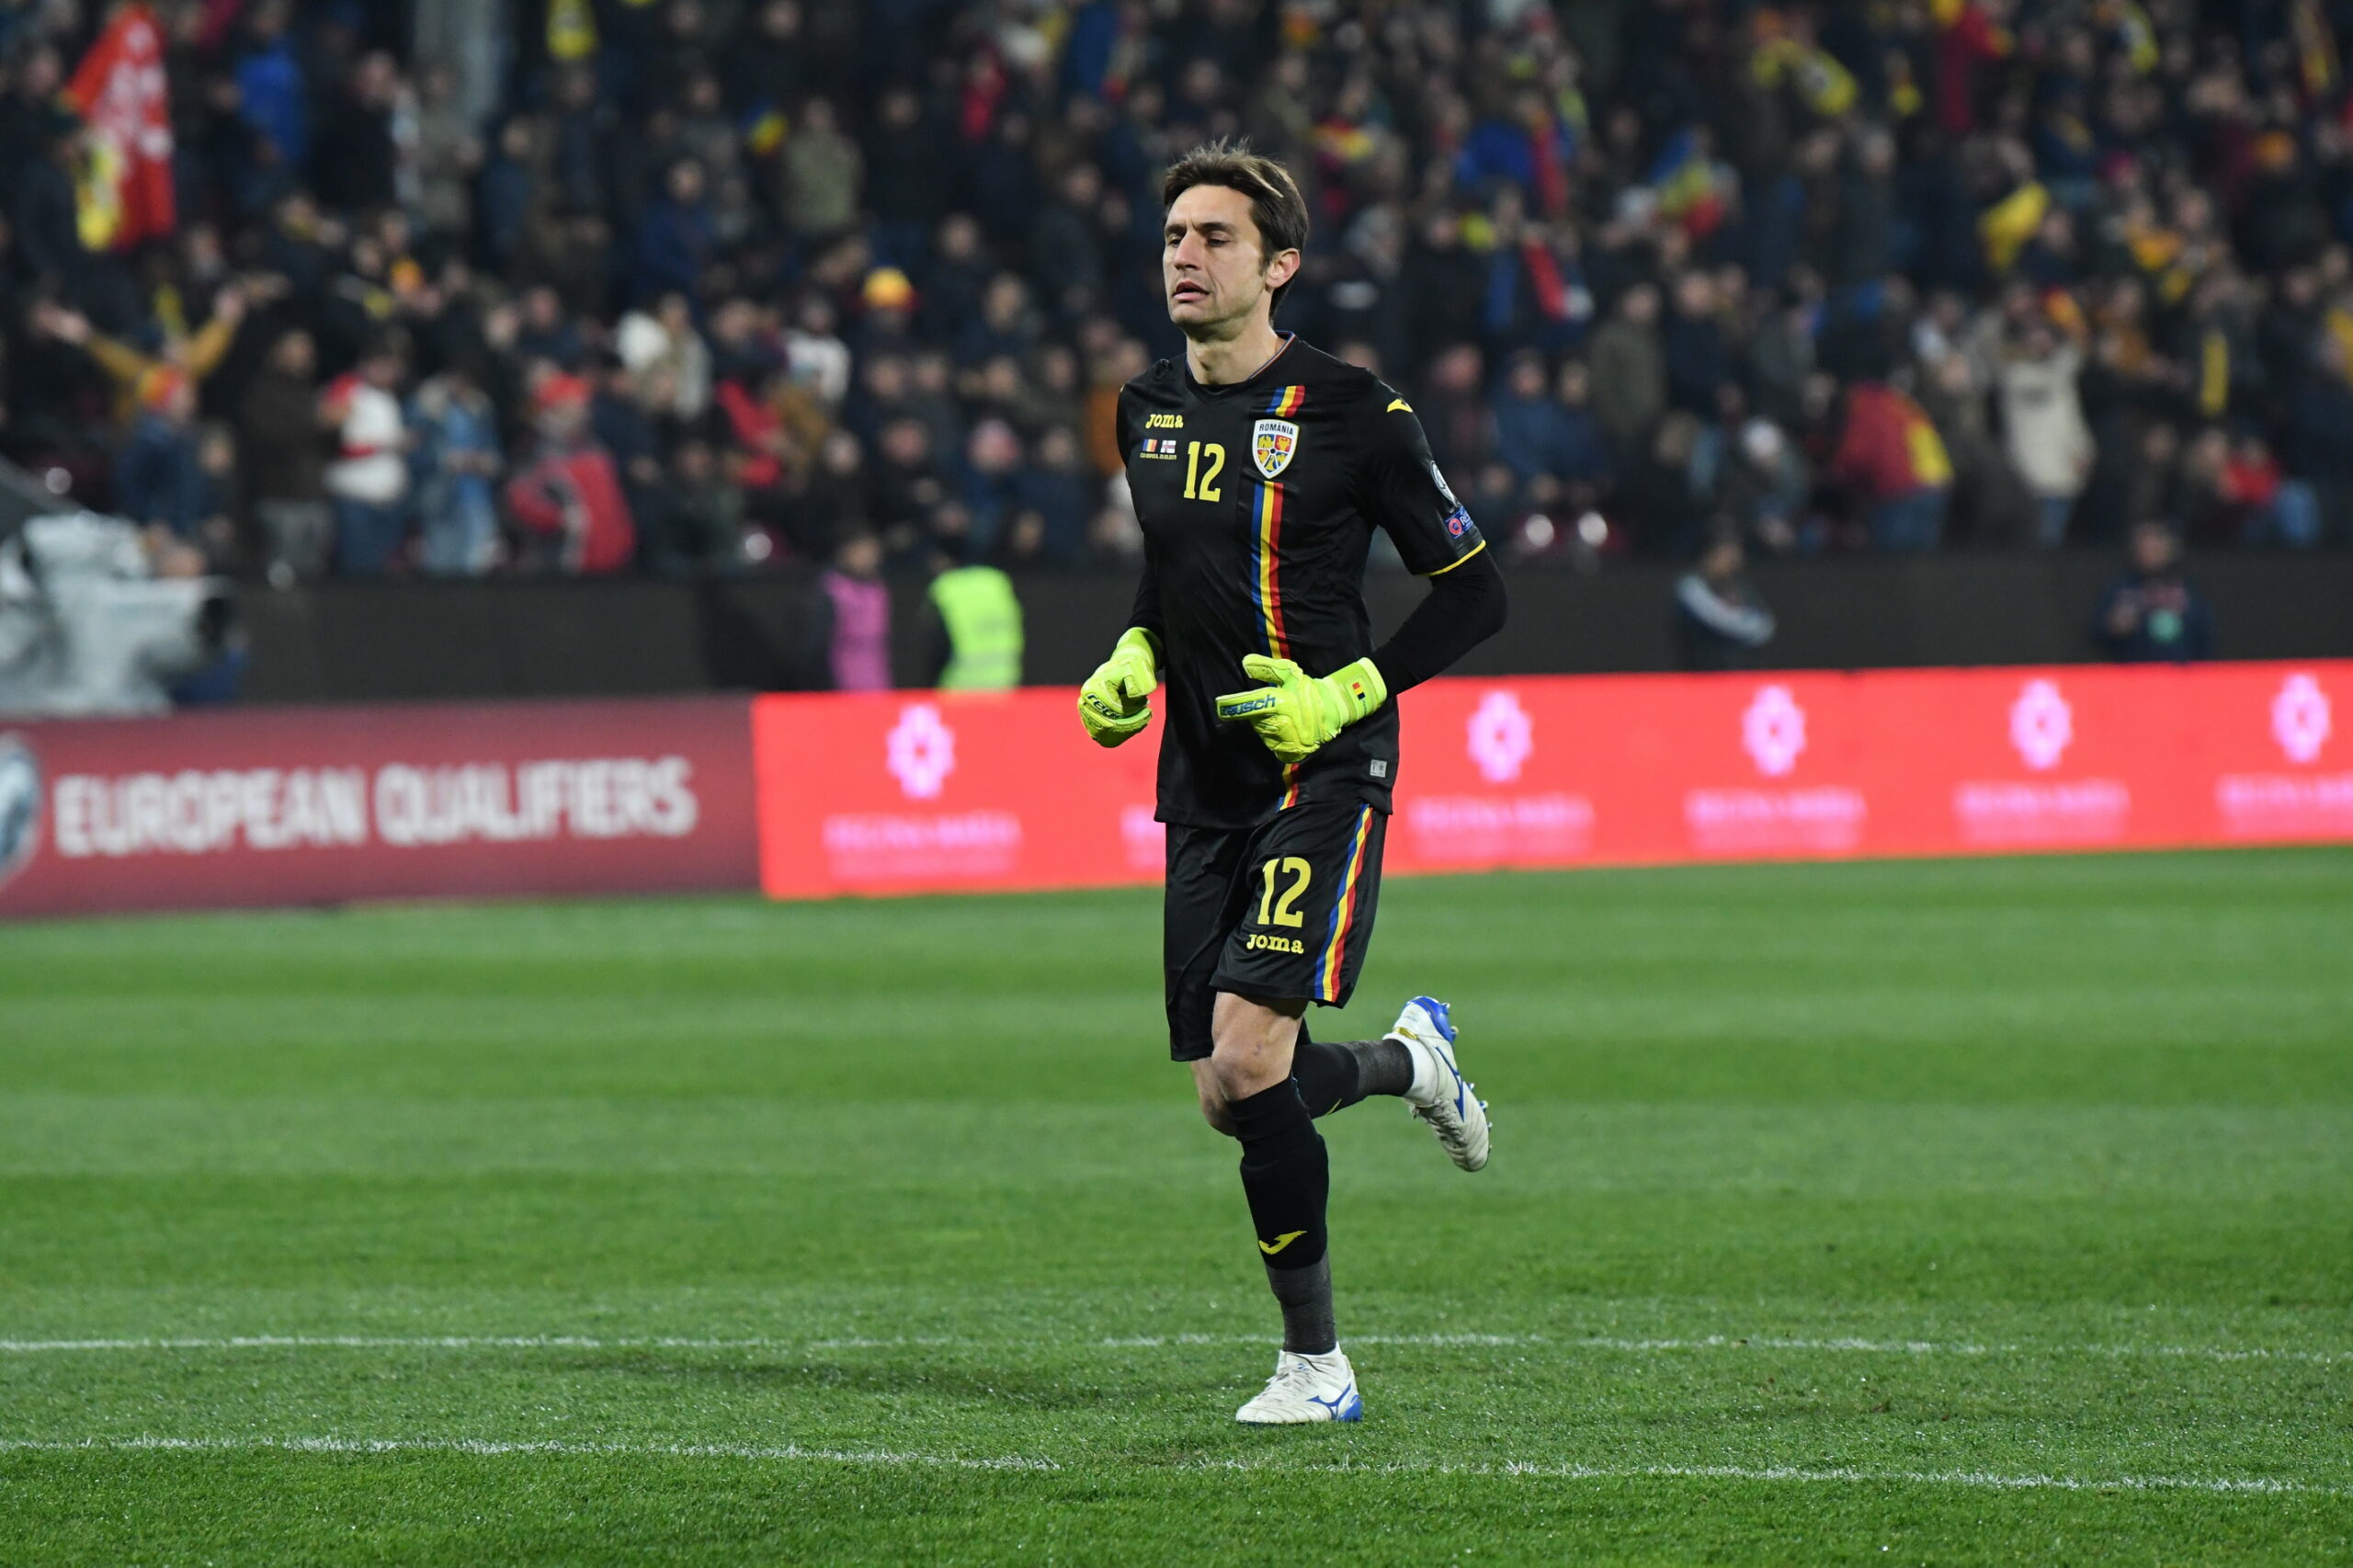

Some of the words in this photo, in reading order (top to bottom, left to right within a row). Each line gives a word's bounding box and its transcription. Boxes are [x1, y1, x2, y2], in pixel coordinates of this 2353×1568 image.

[1259, 423, 1294, 436] ROMÂNIA
[1183, 441, 1226, 503] 12
[54, 770, 369, 857] EUROPEAN
[375, 756, 699, 846] QUALIFIERS
[1256, 857, 1312, 928] 12
